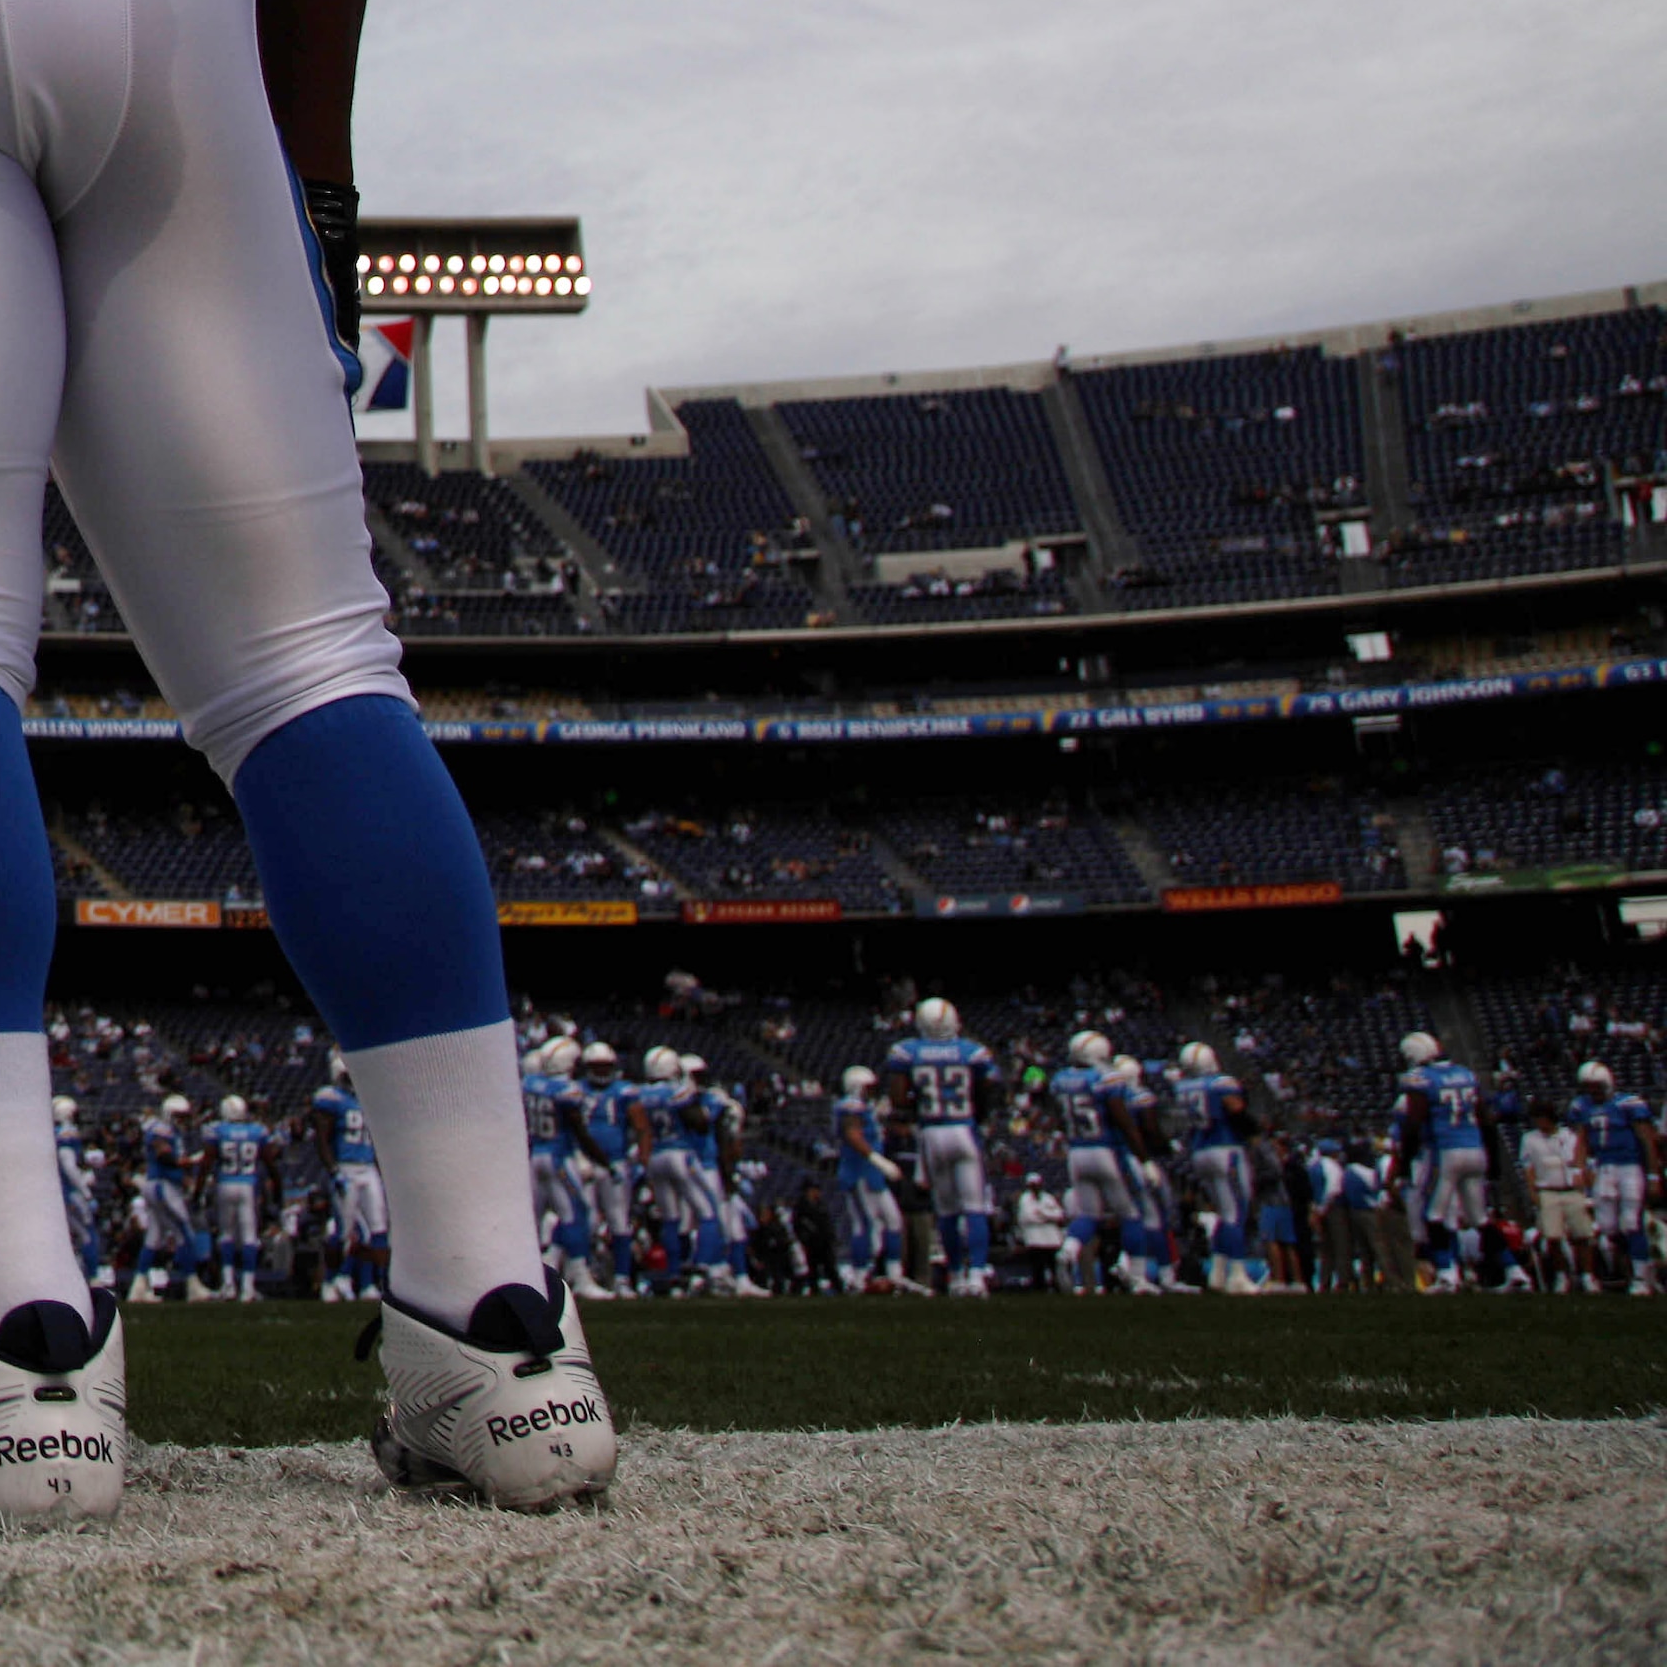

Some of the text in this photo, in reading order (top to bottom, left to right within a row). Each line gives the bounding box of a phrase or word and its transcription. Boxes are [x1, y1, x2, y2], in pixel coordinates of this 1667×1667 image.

[1338, 688, 1403, 713] GARY
[1406, 676, 1514, 705] JOHNSON
[86, 901, 208, 925] CYMER
[913, 1065, 973, 1120] 33
[486, 1394, 602, 1447] Reebok
[549, 1442, 574, 1458] 43
